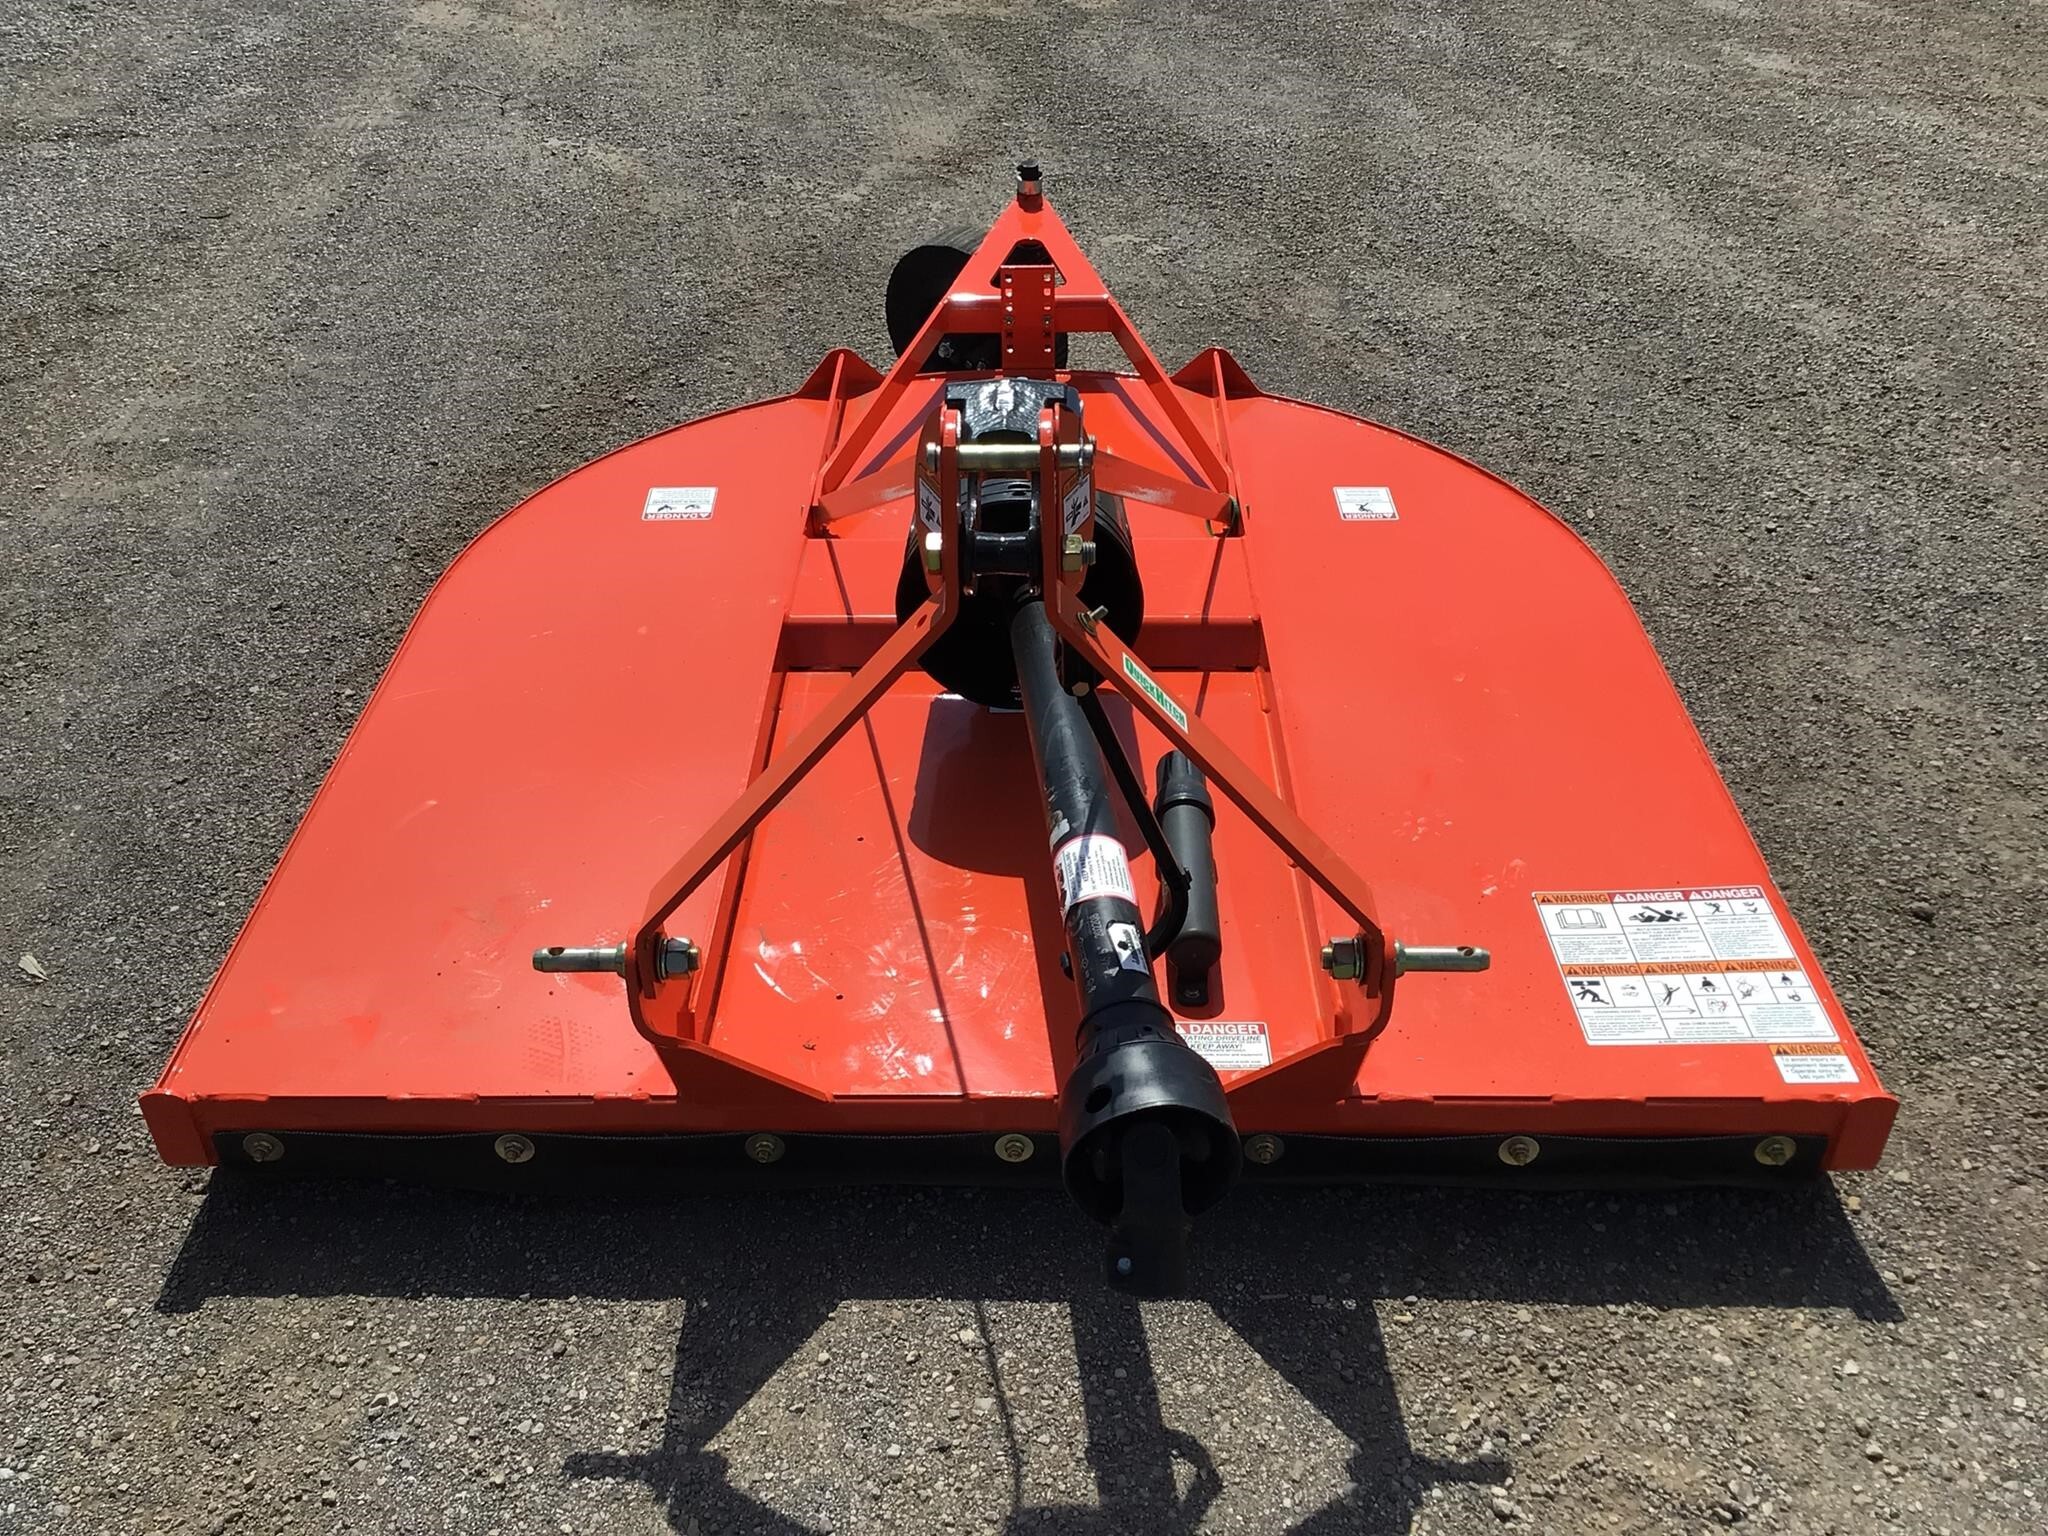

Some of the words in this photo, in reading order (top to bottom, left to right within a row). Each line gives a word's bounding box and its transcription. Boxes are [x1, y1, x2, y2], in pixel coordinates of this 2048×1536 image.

[1553, 893, 1608, 903] WARNING
[1626, 891, 1685, 902] DANGER
[1700, 888, 1760, 899] DANGER
[1580, 965, 1638, 975] WARNING
[1659, 963, 1716, 973] WARNING
[1736, 960, 1797, 970] WARNING
[1189, 1024, 1260, 1034] DANGER
[1790, 1044, 1841, 1054] WARNING
